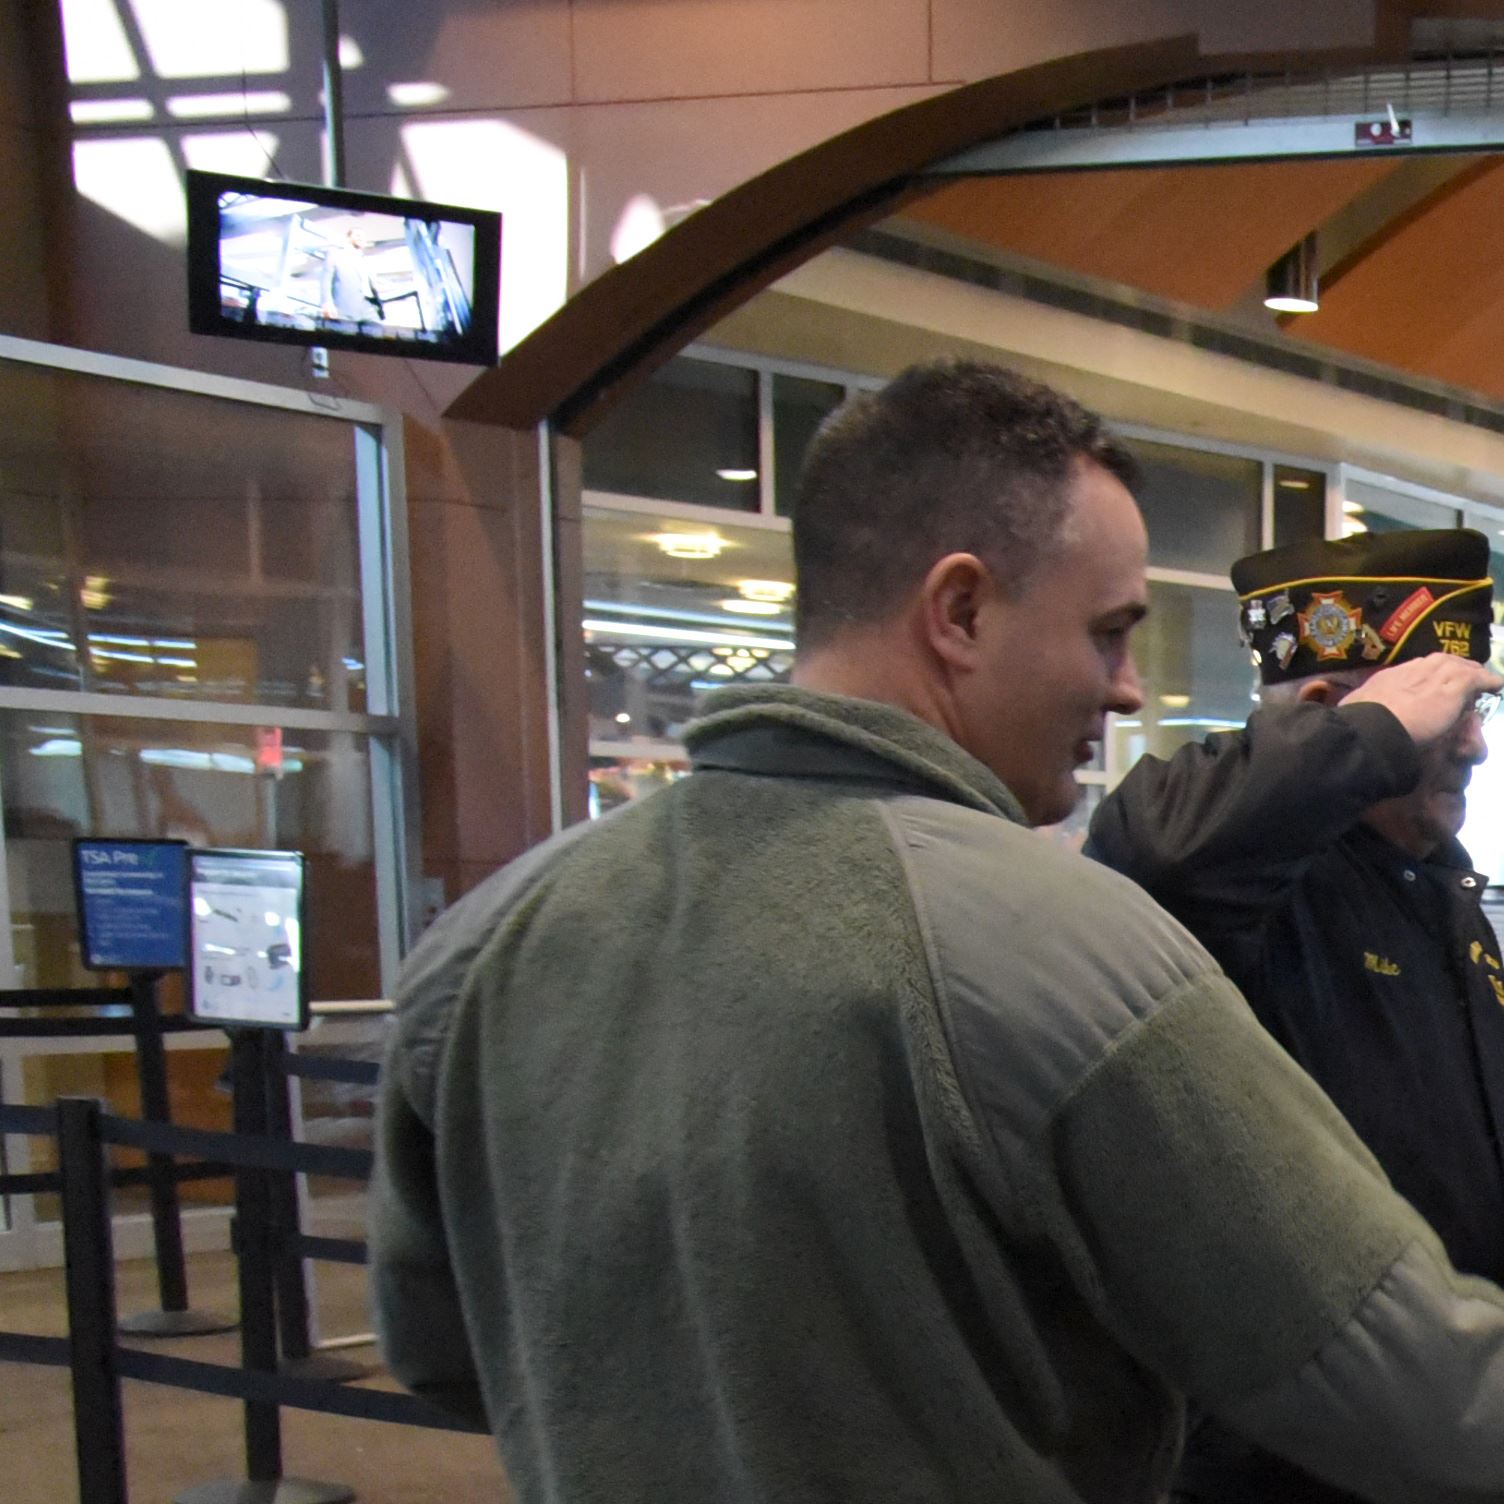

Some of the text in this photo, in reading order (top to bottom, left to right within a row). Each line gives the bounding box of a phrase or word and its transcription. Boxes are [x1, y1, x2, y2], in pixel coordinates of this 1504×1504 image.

[1433, 620, 1472, 639] VFW
[1441, 638, 1471, 657] 762
[80, 849, 111, 865] TSA
